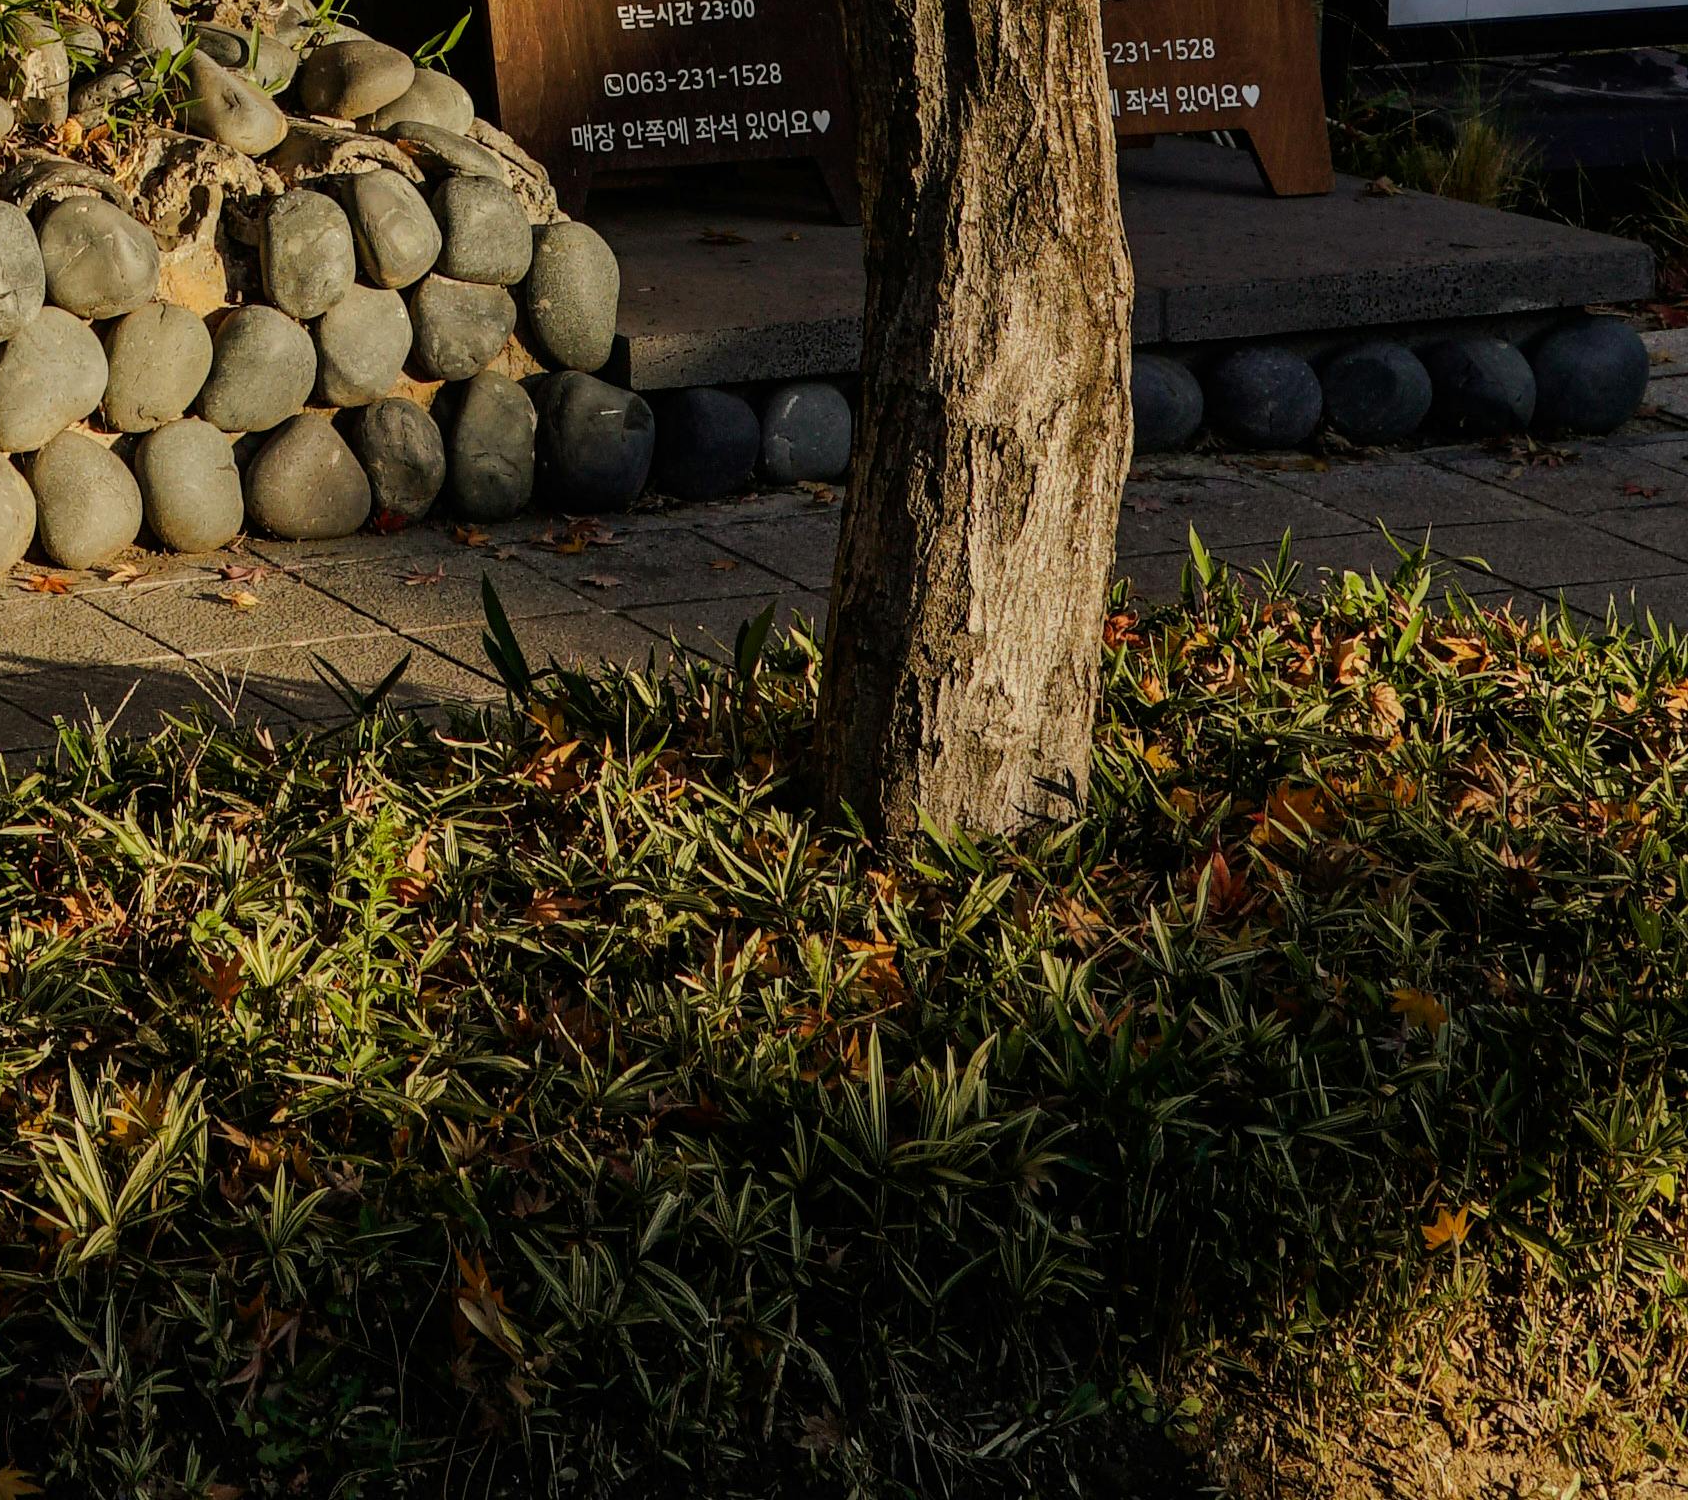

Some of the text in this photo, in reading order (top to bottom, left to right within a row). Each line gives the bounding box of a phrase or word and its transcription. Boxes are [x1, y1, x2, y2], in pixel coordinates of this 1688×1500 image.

[616, 0, 694, 30] 닫는시간
[626, 62, 782, 94] 063-231-1528
[1125, 86, 1170, 116] 좌석
[1175, 83, 1242, 113] 있어요
[570, 109, 812, 153] 매장 안쪽에 좌석 있어요
